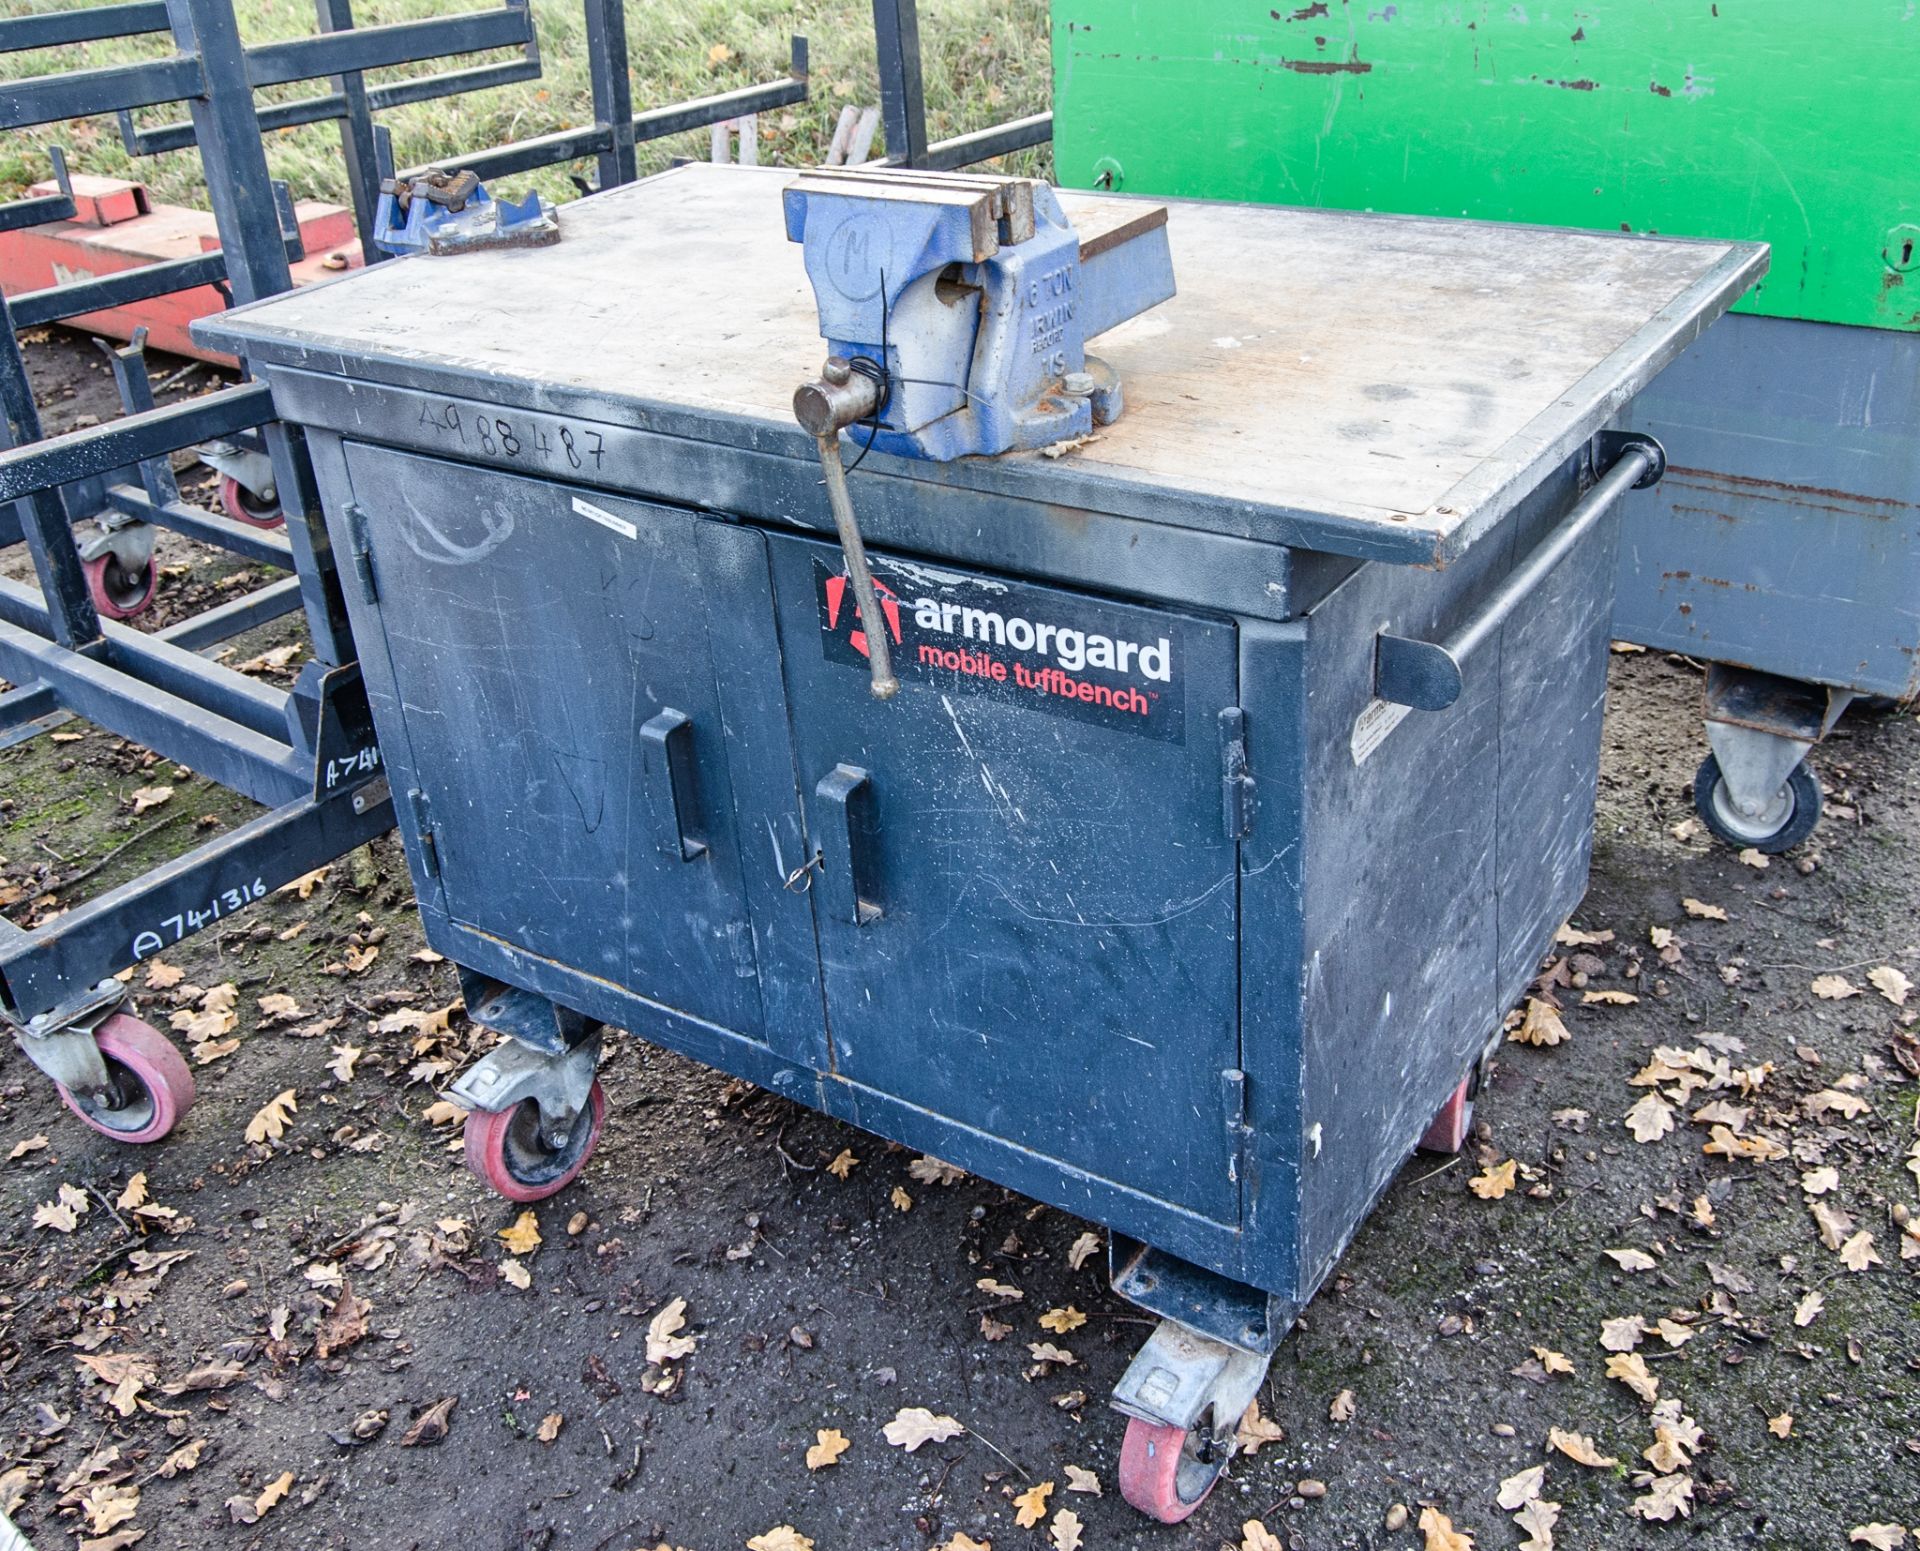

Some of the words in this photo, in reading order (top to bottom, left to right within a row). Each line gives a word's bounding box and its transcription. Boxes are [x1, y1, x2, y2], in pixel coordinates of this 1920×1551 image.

[1042, 263, 1073, 301] TON
[1030, 300, 1074, 337] IRWIN
[914, 597, 1171, 683] armorgard
[918, 645, 1008, 682] mobile
[133, 877, 267, 959] A741316
